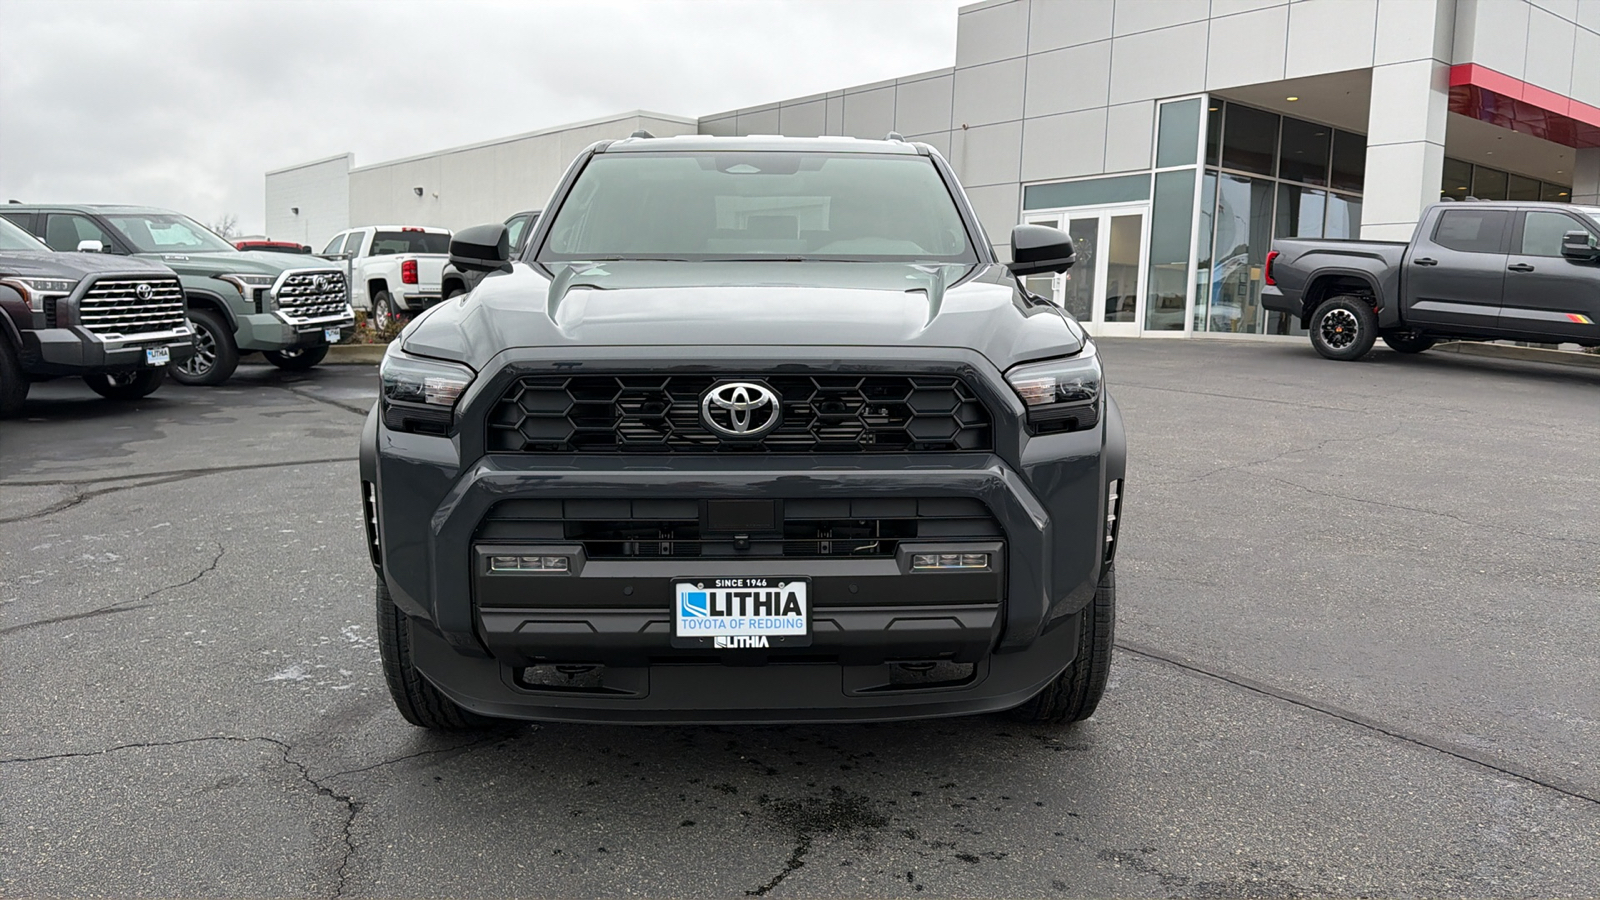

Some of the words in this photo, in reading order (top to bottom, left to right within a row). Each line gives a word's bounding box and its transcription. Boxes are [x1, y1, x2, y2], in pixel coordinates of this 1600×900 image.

[715, 579, 743, 587] SINCE
[746, 579, 767, 587] 1946
[709, 591, 803, 617] LITHIA
[682, 618, 726, 630] TOYOTA
[729, 619, 745, 630] OF
[749, 618, 803, 630] REDDING
[726, 635, 770, 648] LITHIA
